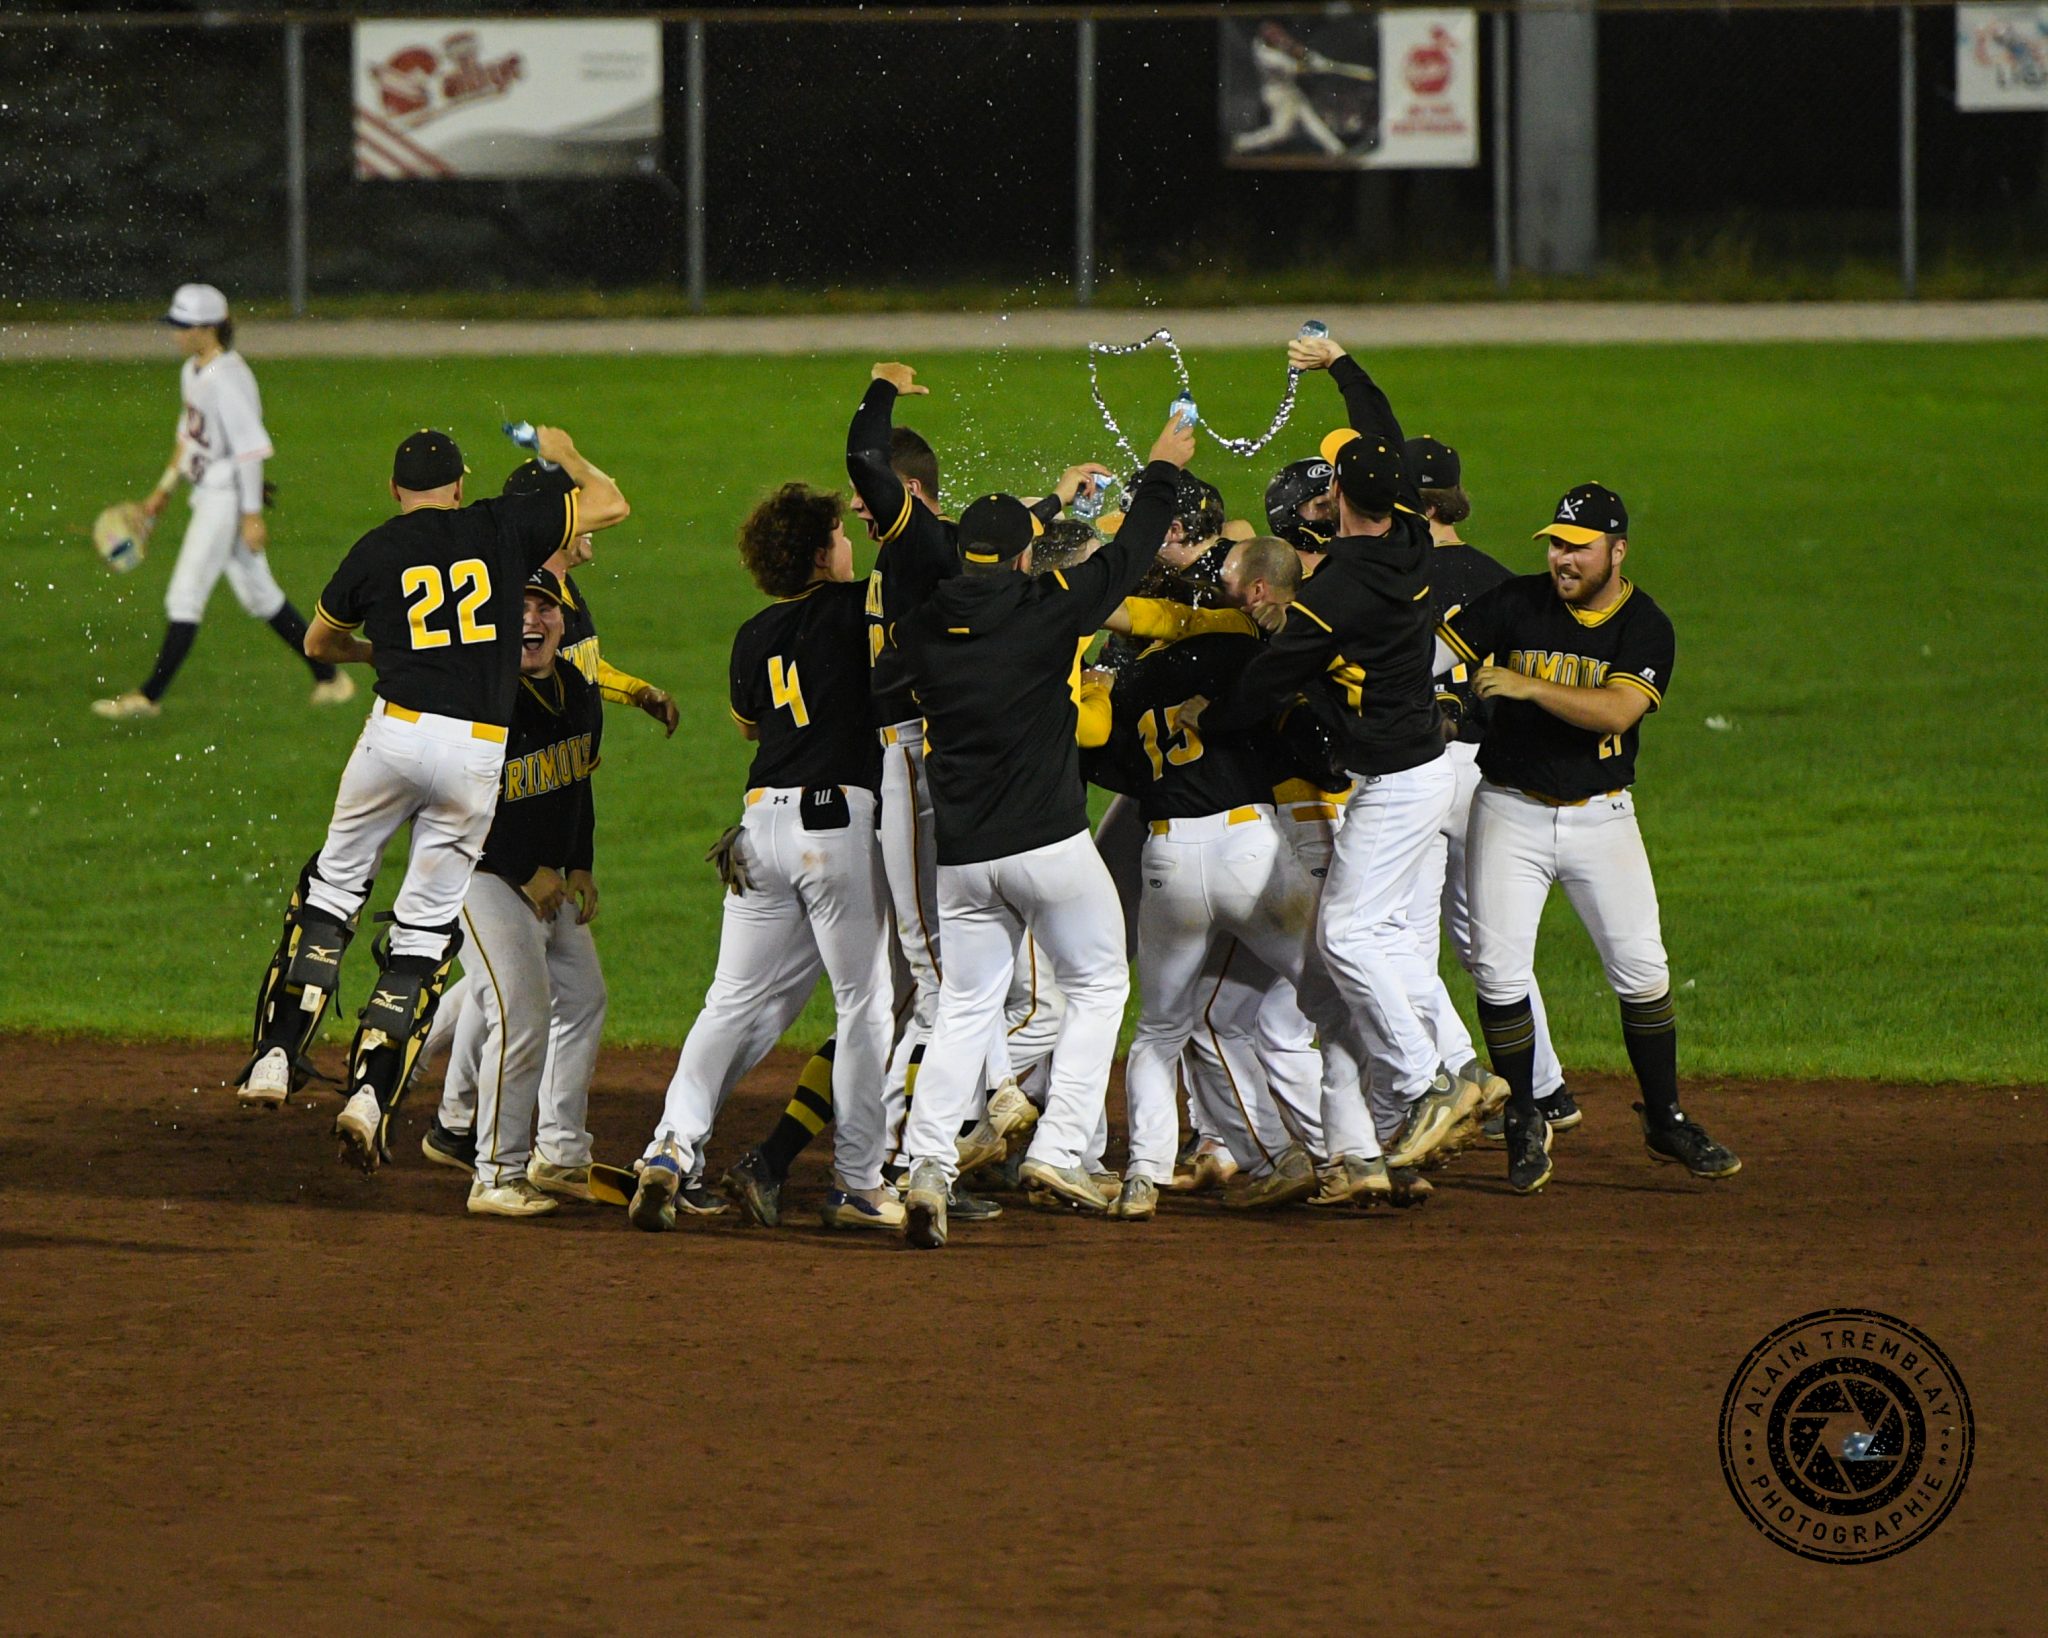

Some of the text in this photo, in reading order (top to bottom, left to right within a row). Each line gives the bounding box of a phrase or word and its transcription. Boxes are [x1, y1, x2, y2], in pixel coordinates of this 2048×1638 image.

[401, 558, 497, 650] 22
[768, 655, 810, 728] 4
[1137, 701, 1204, 781] 15
